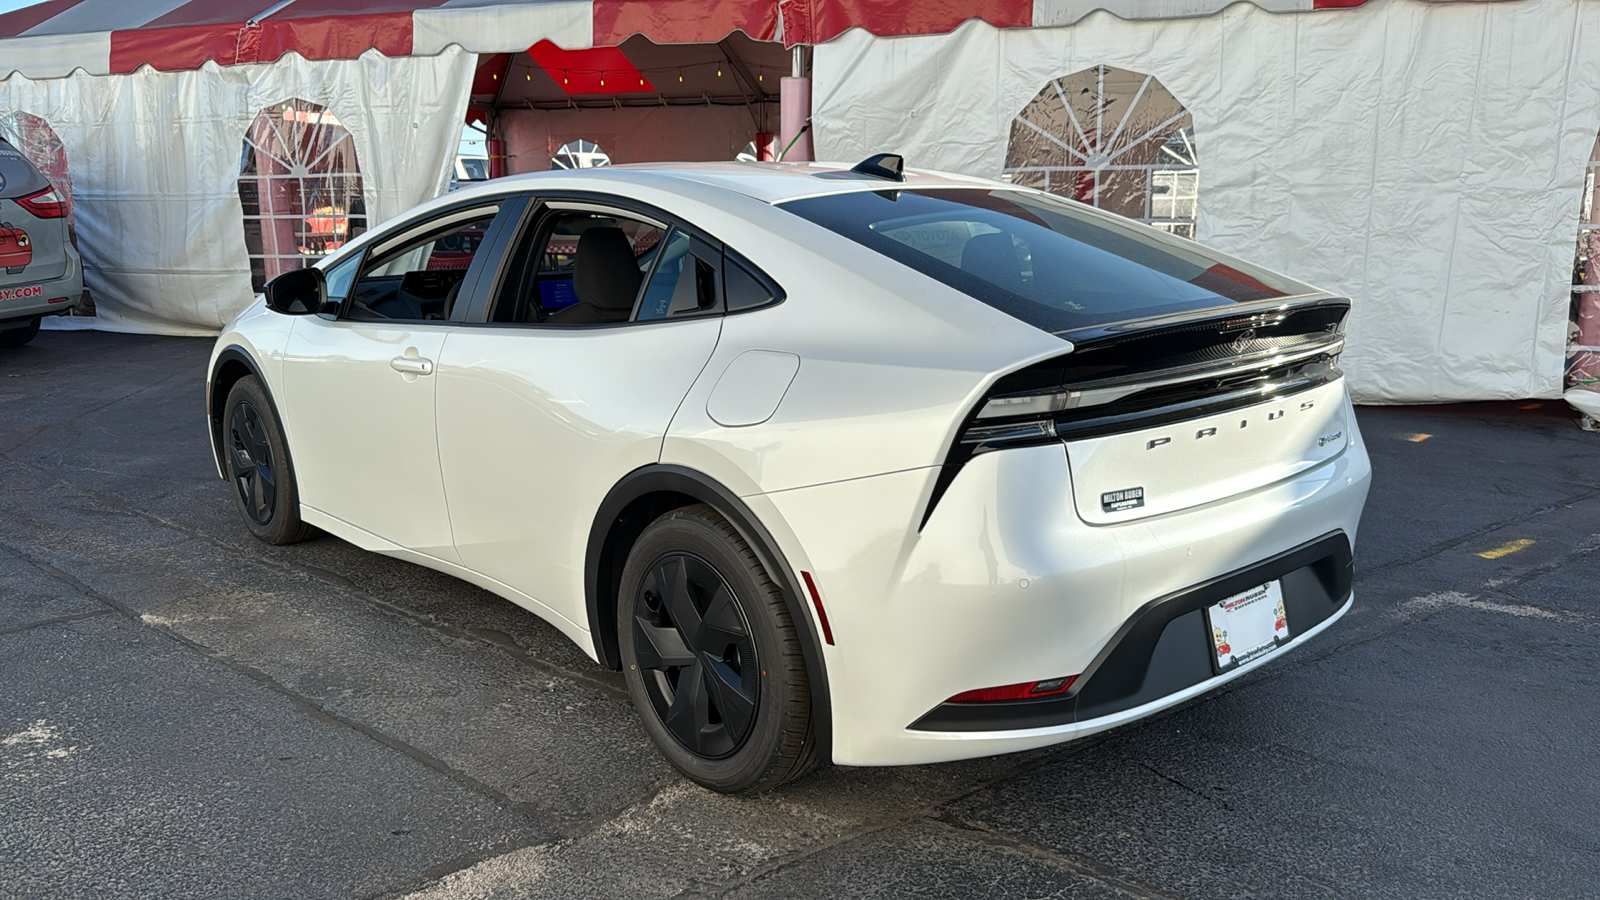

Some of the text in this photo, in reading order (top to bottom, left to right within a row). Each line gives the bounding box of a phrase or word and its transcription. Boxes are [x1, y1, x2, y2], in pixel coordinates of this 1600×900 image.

[1146, 400, 1314, 450] PRIUS
[1103, 492, 1123, 503] MILTON
[1245, 589, 1266, 601] RUBEN
